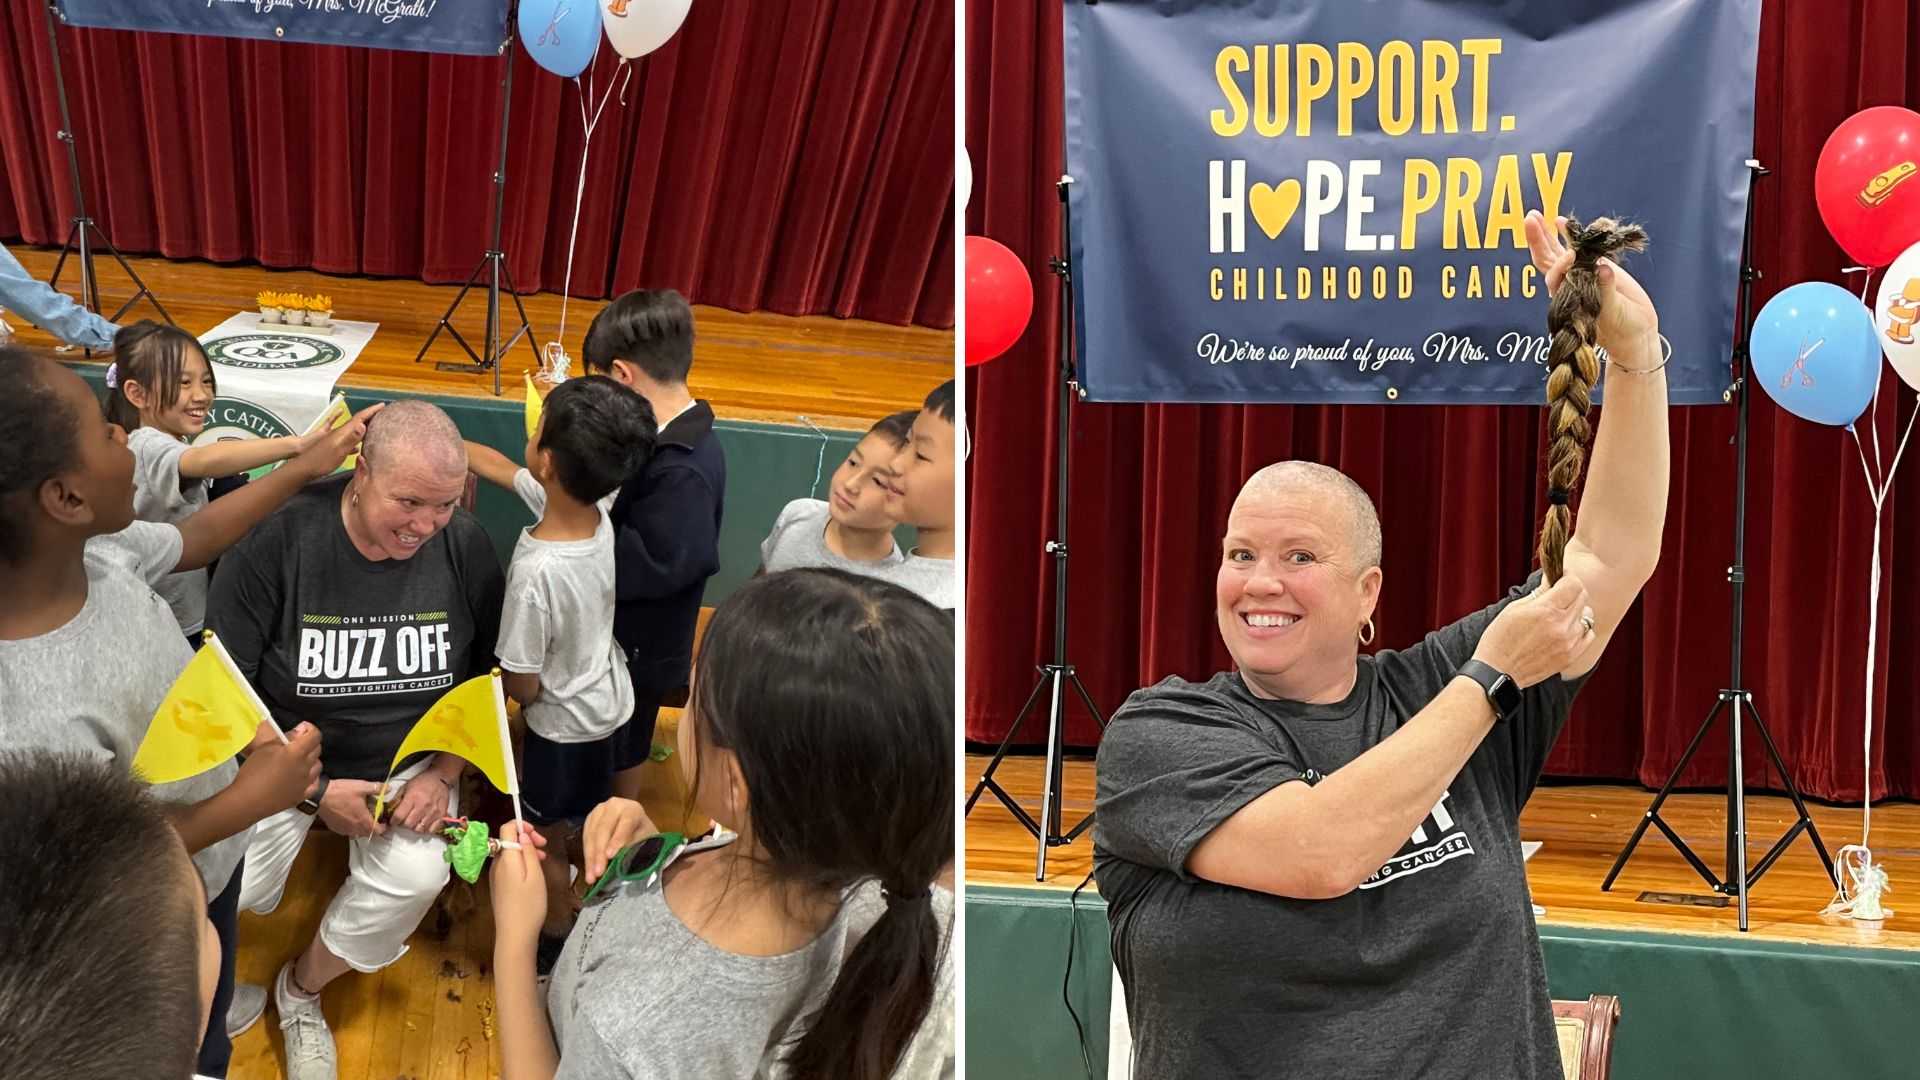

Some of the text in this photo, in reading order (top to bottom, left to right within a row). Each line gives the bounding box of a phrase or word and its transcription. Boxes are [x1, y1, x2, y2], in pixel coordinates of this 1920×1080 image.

[1210, 38, 1516, 137] SUPPORT.
[1399, 151, 1573, 250] PRAY
[1209, 264, 1538, 301] CHILDHOOD CANC
[1196, 332, 1266, 364] We're
[1268, 344, 1289, 363] so
[1290, 337, 1351, 372] proud
[1352, 339, 1373, 372] of
[1377, 346, 1416, 372] you,
[1422, 332, 1490, 365] Mrs.
[342, 614, 415, 624] ONE MISSION
[298, 623, 451, 680] BUZZ OFF
[304, 678, 448, 694] FOR KIDS FIGHTING CANCER
[1401, 838, 1466, 870] CANCER
